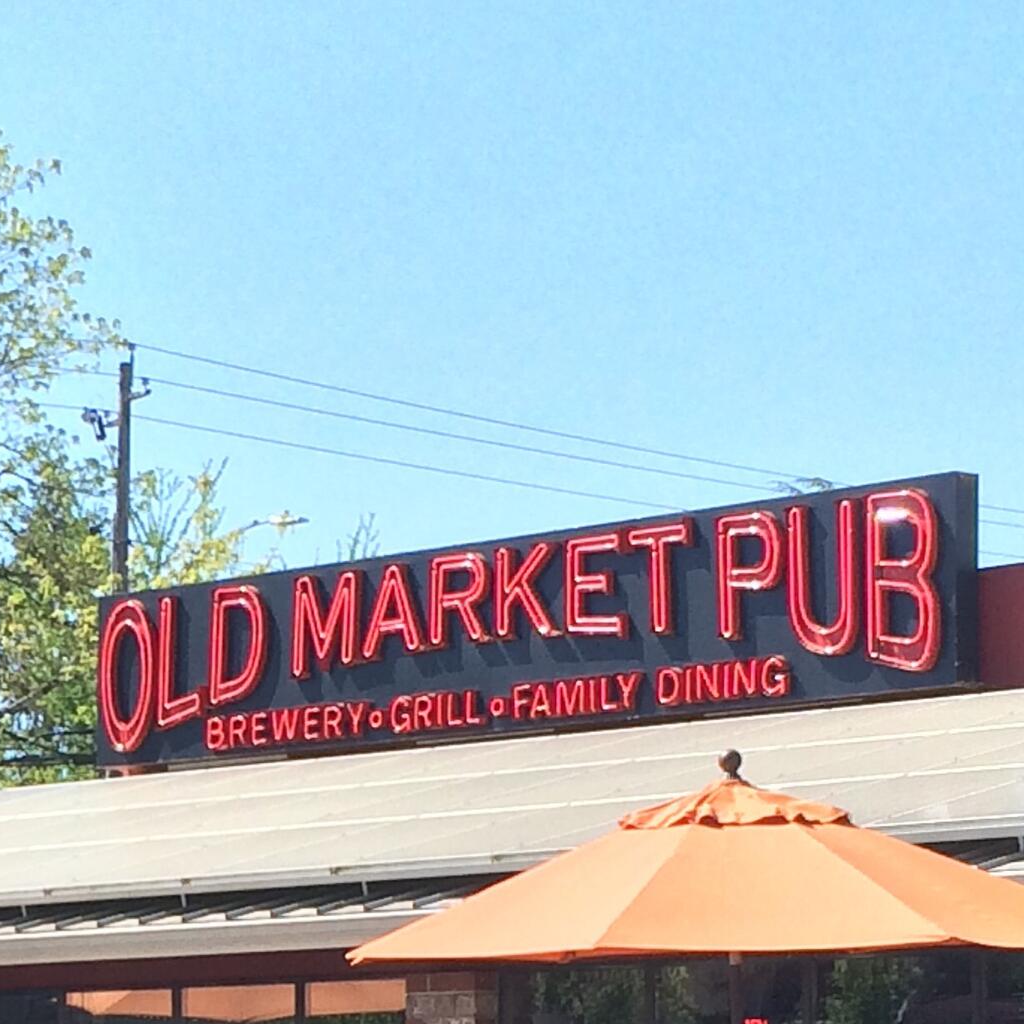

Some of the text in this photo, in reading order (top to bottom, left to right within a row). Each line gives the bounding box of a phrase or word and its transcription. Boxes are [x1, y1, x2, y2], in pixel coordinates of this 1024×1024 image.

[99, 487, 941, 753] OLD MARKET PUB
[206, 655, 790, 751] BREWERY GRILL FAMILY DINING
